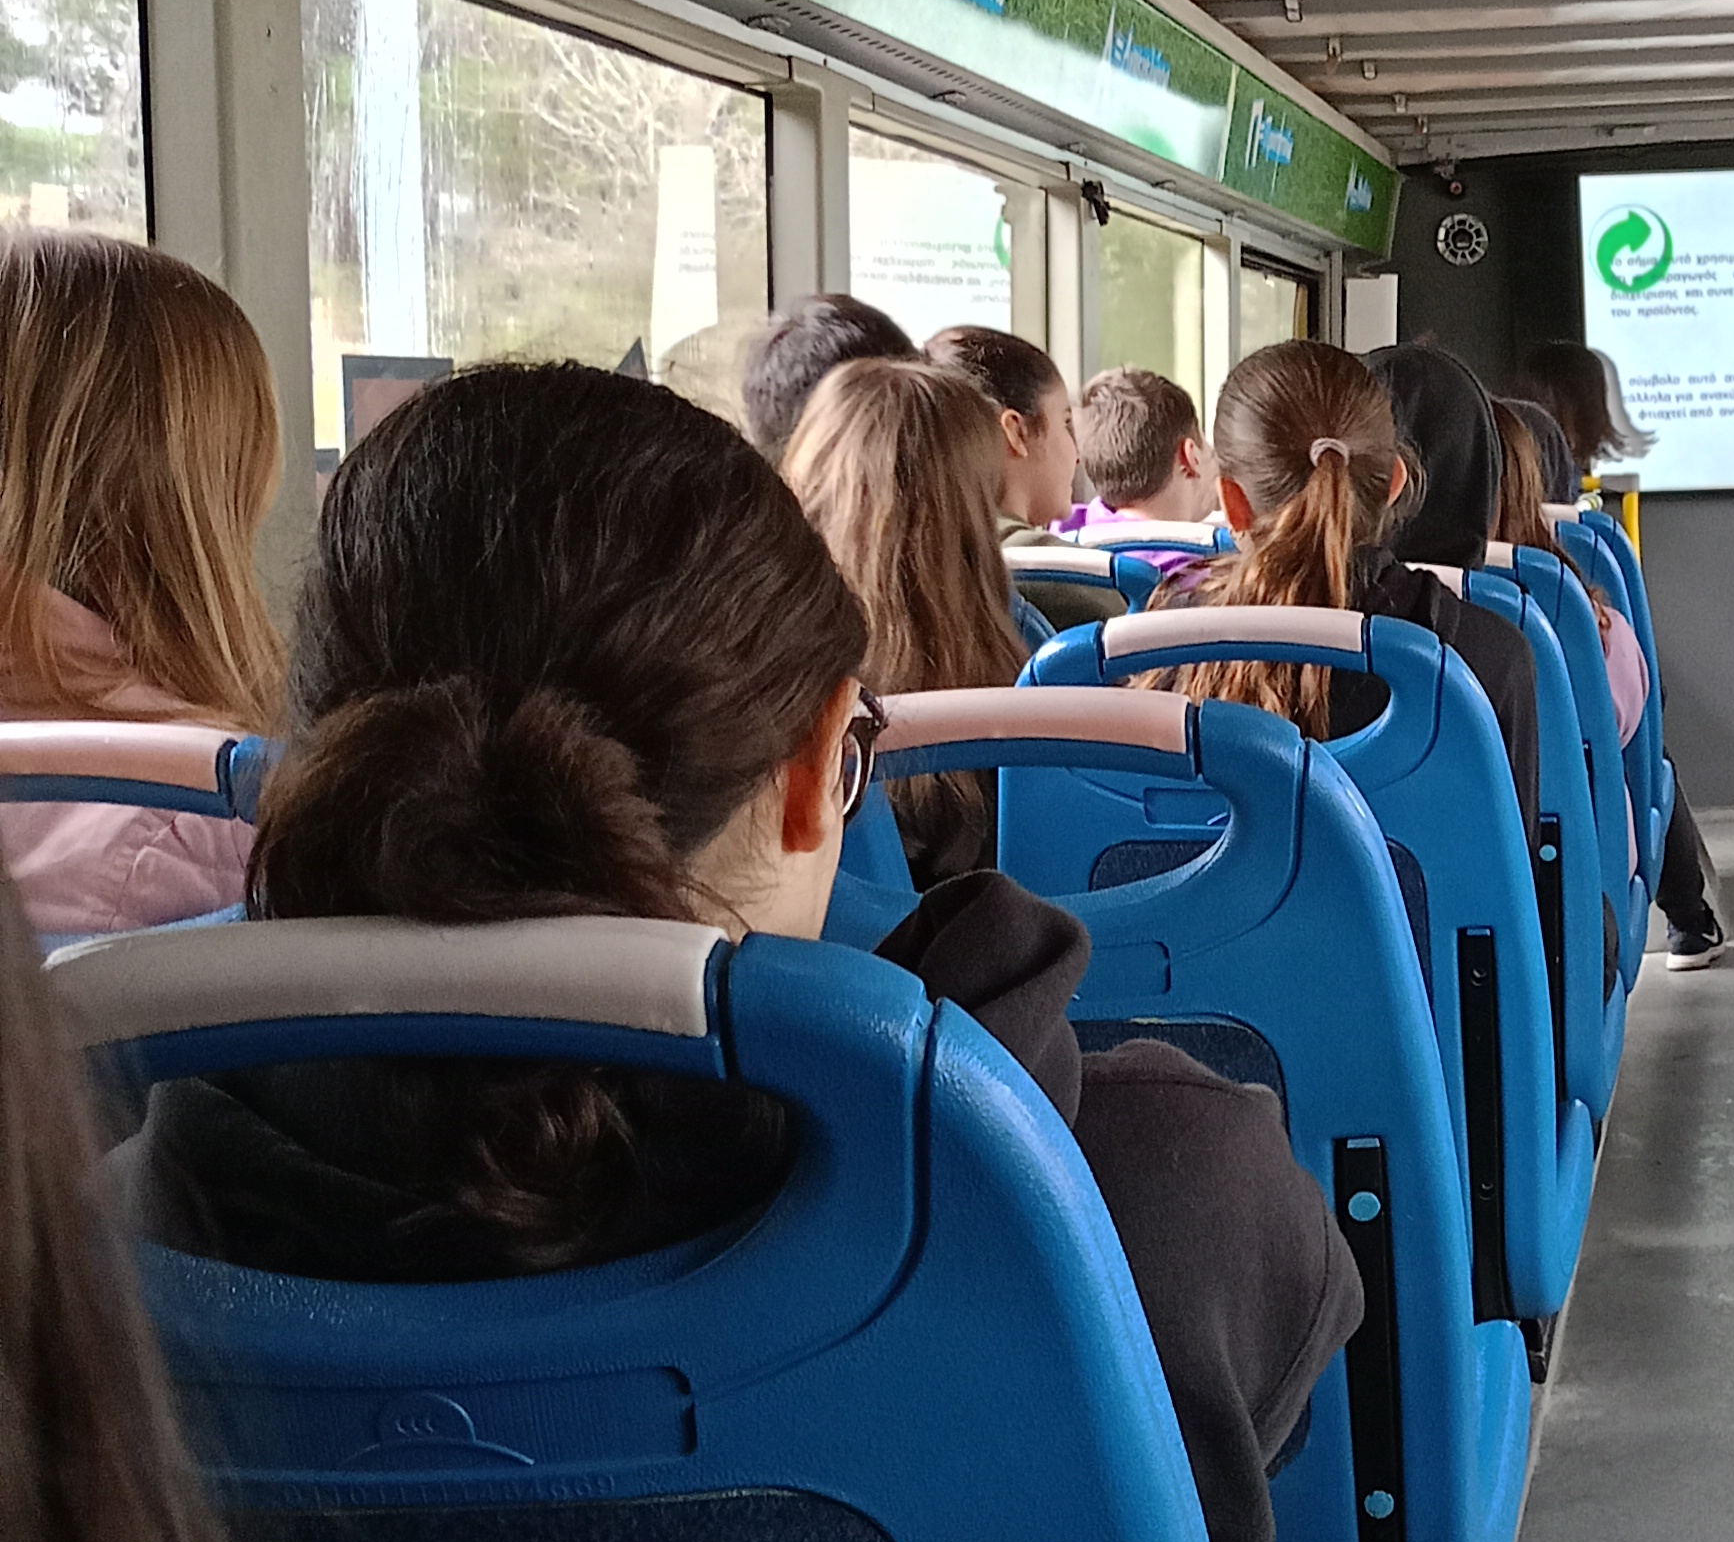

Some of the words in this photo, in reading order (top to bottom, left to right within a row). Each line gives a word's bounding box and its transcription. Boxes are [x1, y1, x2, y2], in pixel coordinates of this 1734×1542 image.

[1685, 288, 1703, 298] και
[1611, 308, 1631, 318] του
[1629, 372, 1680, 387] σύμβολο
[1688, 371, 1717, 385] αυτό
[1675, 391, 1693, 403] για
[1690, 405, 1713, 418] από
